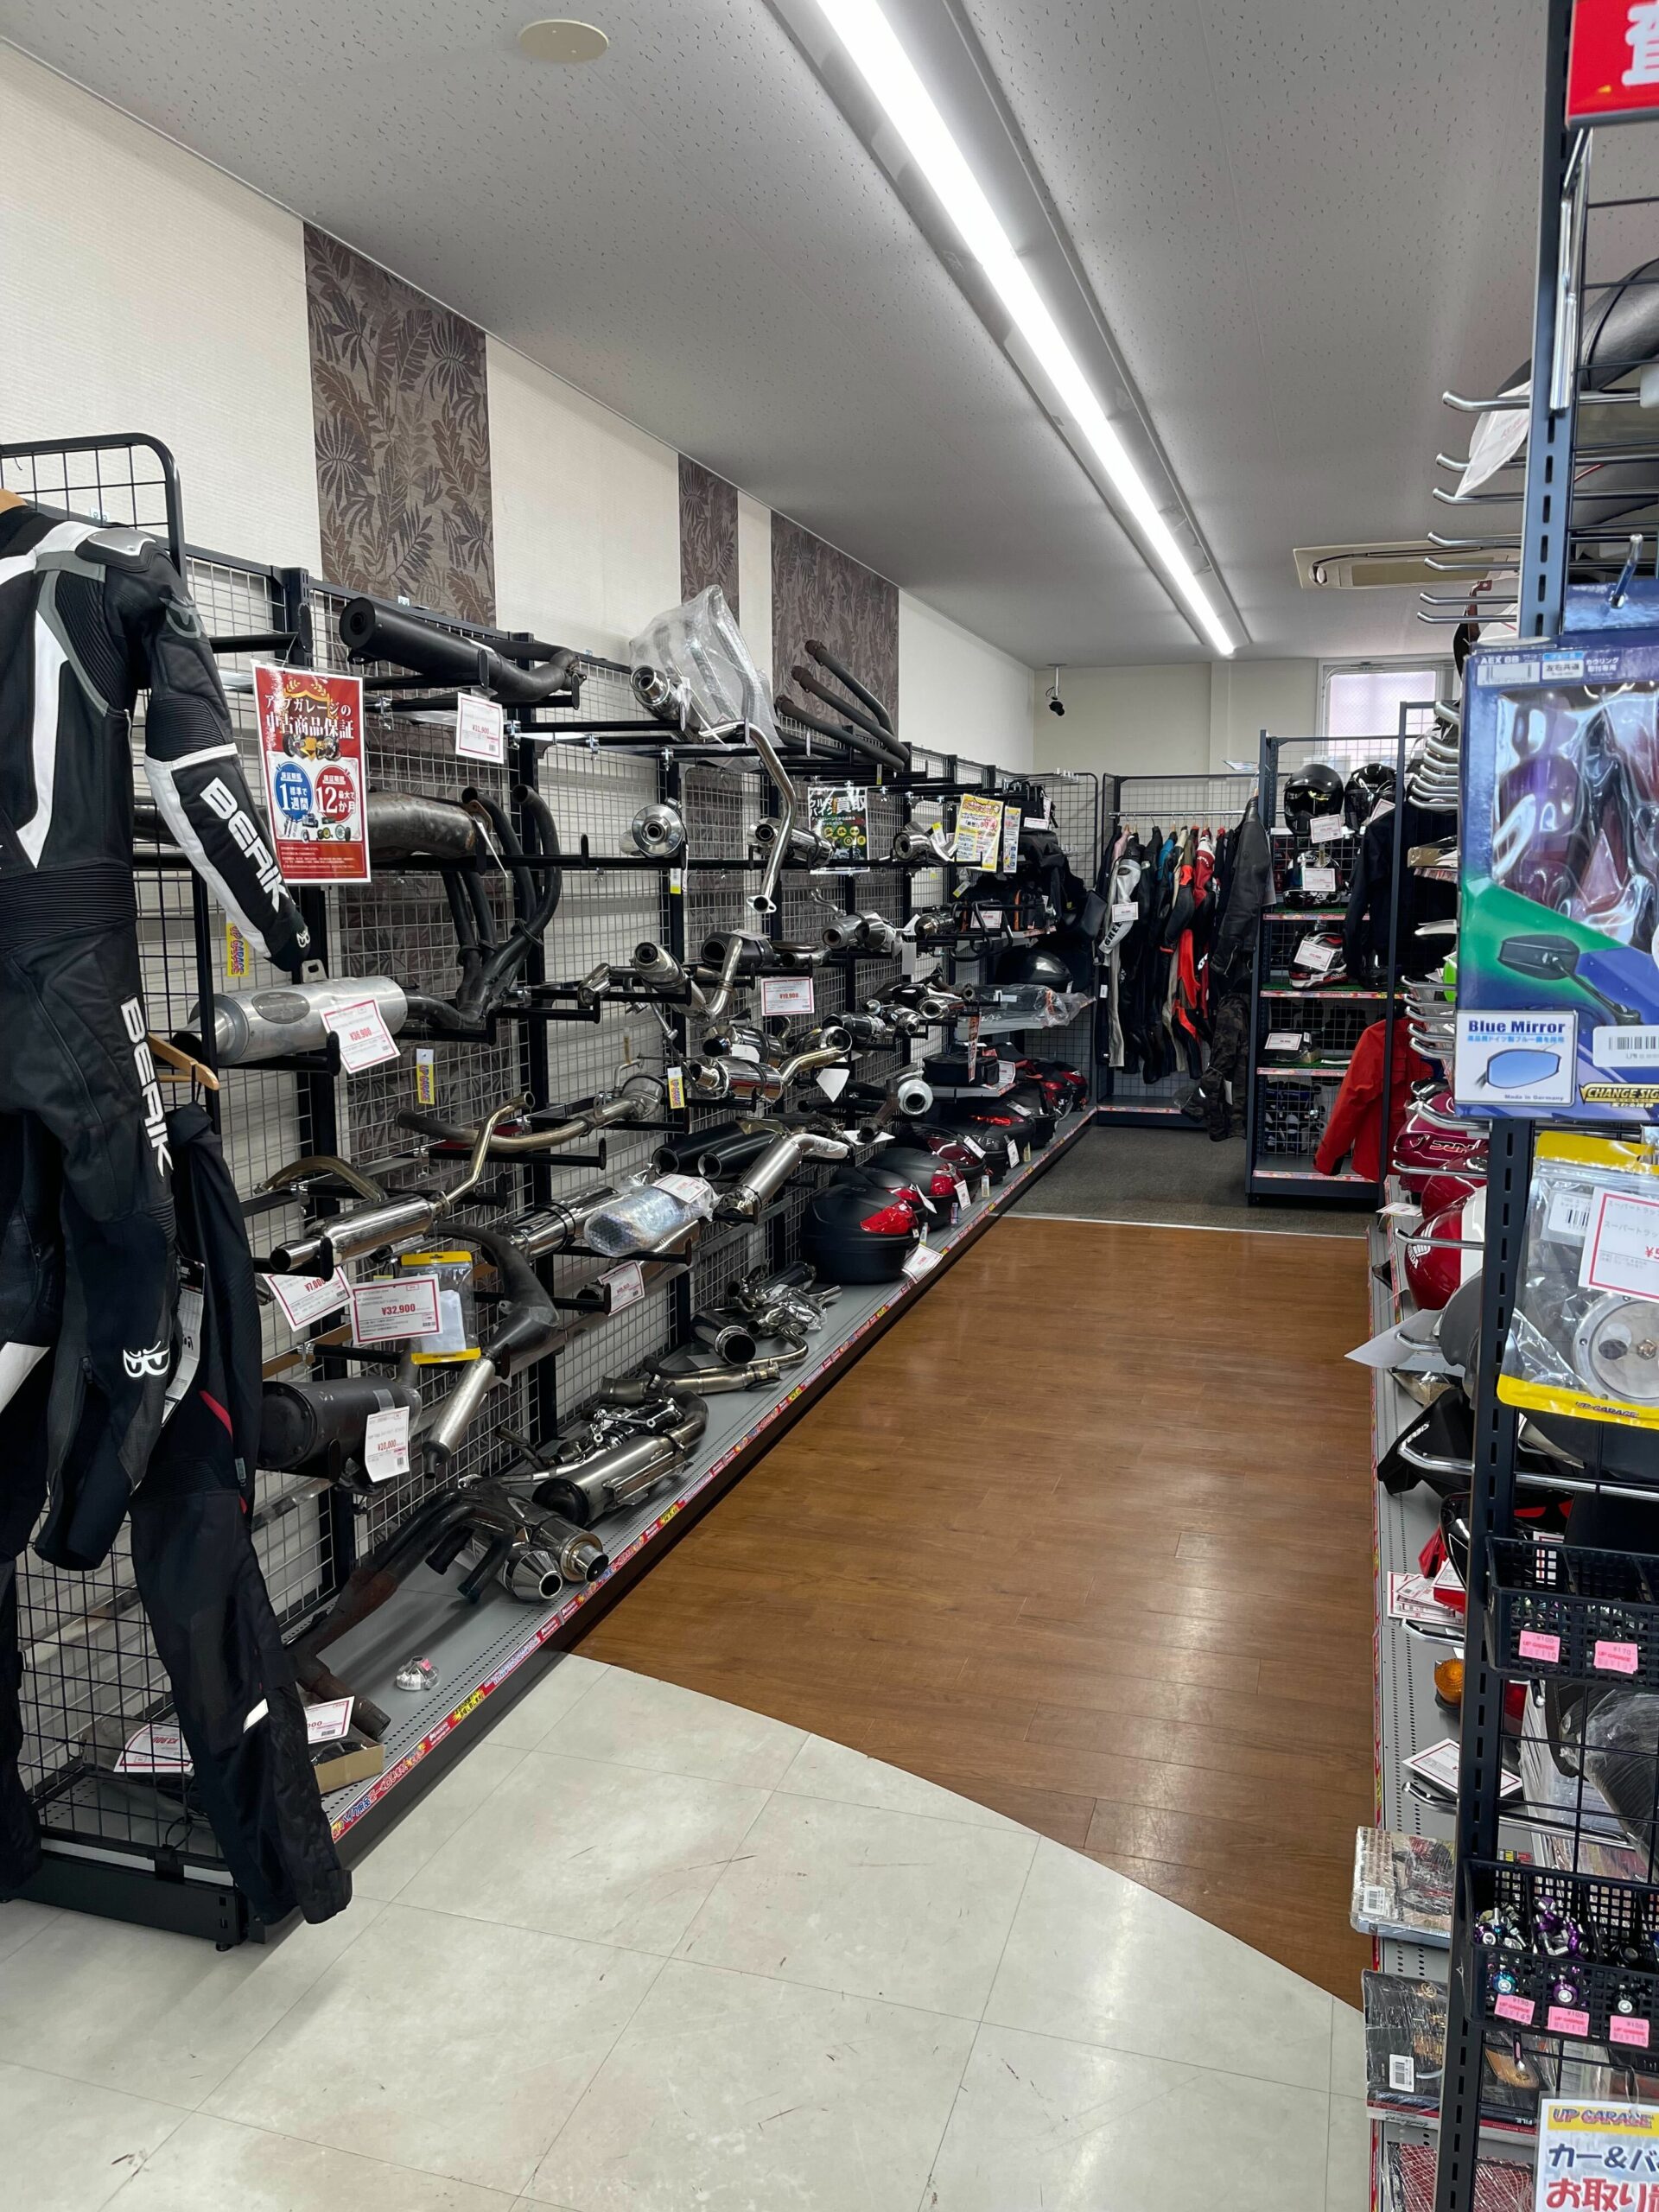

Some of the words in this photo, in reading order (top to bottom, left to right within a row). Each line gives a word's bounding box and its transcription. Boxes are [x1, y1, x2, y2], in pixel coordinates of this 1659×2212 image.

[265, 695, 351, 716] アプガレージの
[266, 711, 354, 739] 中古商品保証
[200, 777, 296, 913] BERIK
[230, 939, 245, 975] GARAGE
[1469, 1020, 1507, 1033] Blue
[1511, 1020, 1566, 1033] Mirror
[121, 997, 175, 1177] BERIK
[1586, 1088, 1637, 1099] CHANGE
[381, 1303, 416, 1316] ¥32,900
[1553, 2108, 1580, 2123] UP
[1580, 2109, 1654, 2129] GARAGE
[1548, 2143, 1659, 2173] カー&バ
